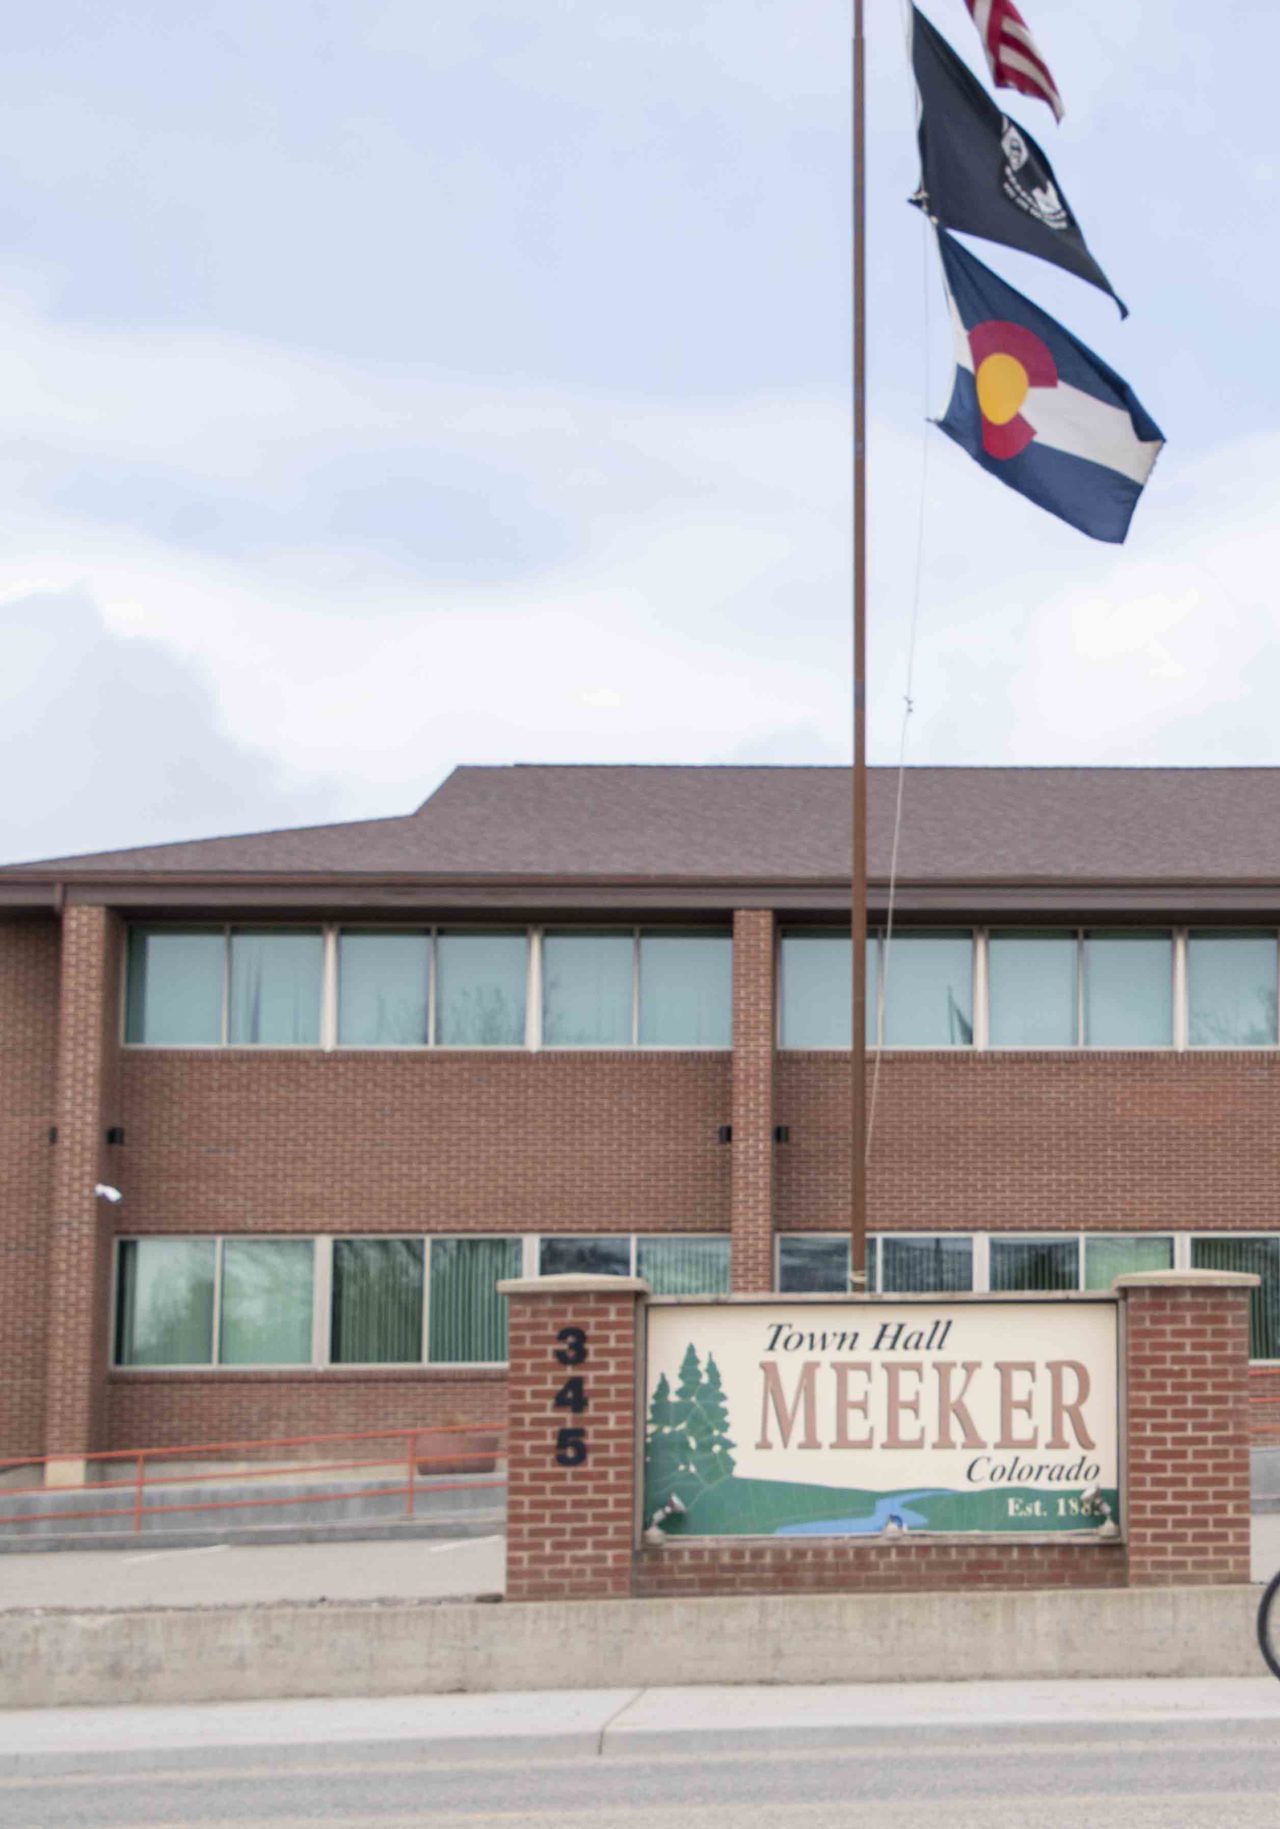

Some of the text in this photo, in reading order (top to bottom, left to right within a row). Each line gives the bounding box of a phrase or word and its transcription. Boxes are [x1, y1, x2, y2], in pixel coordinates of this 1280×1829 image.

[764, 1318, 954, 1352] Town Hall
[754, 1360, 1097, 1451] MEEKER
[966, 1455, 1101, 1484] Colorado
[1007, 1497, 1047, 1517] Est.
